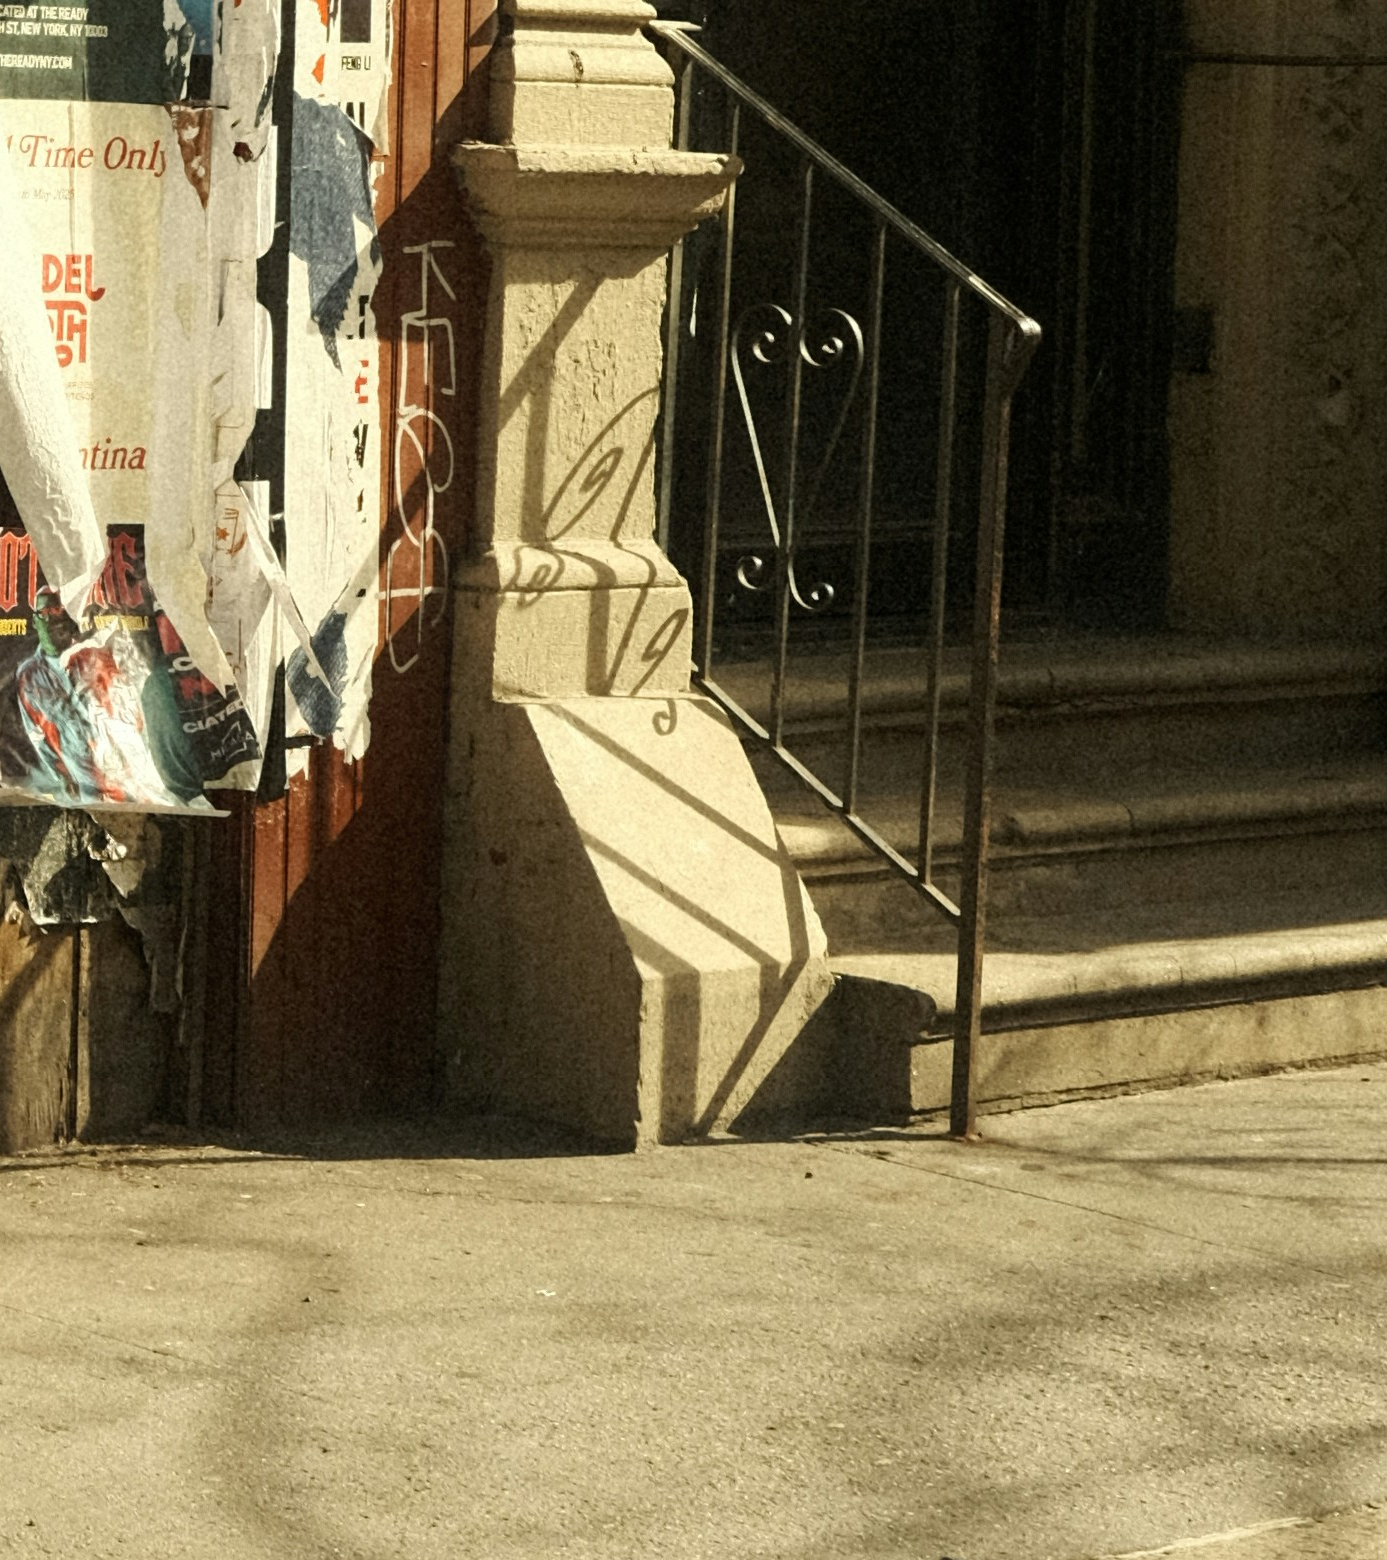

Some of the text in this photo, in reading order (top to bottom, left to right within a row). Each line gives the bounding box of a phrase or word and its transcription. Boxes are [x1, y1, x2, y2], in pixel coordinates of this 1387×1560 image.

[27, 6, 38, 18] AT
[41, 6, 57, 19] THE
[59, 7, 89, 20] READY
[21, 22, 41, 35] NEW
[70, 24, 83, 36] NY
[19, 135, 94, 168] Time
